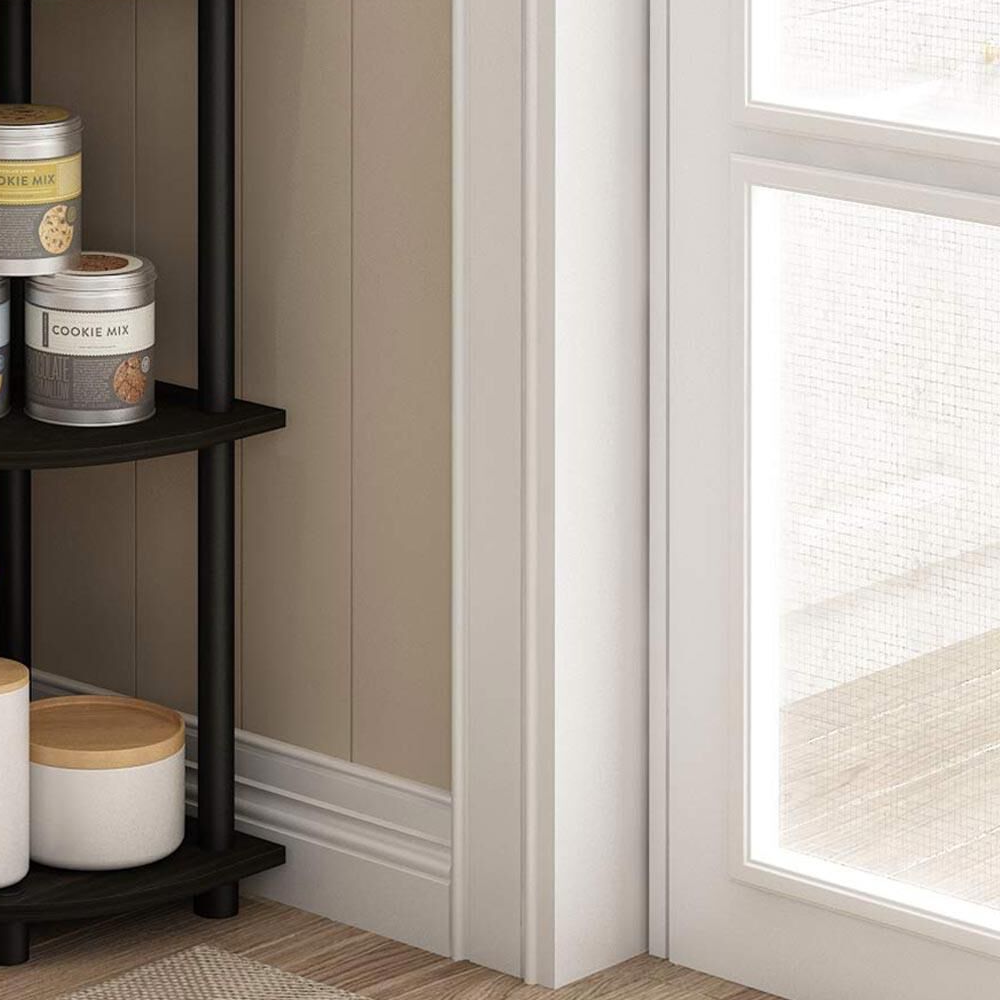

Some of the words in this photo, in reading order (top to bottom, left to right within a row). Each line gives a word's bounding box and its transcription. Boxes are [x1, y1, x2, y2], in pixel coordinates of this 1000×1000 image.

[31, 173, 56, 186] MIX
[52, 325, 103, 338] COOKIE
[106, 325, 129, 337] MIX
